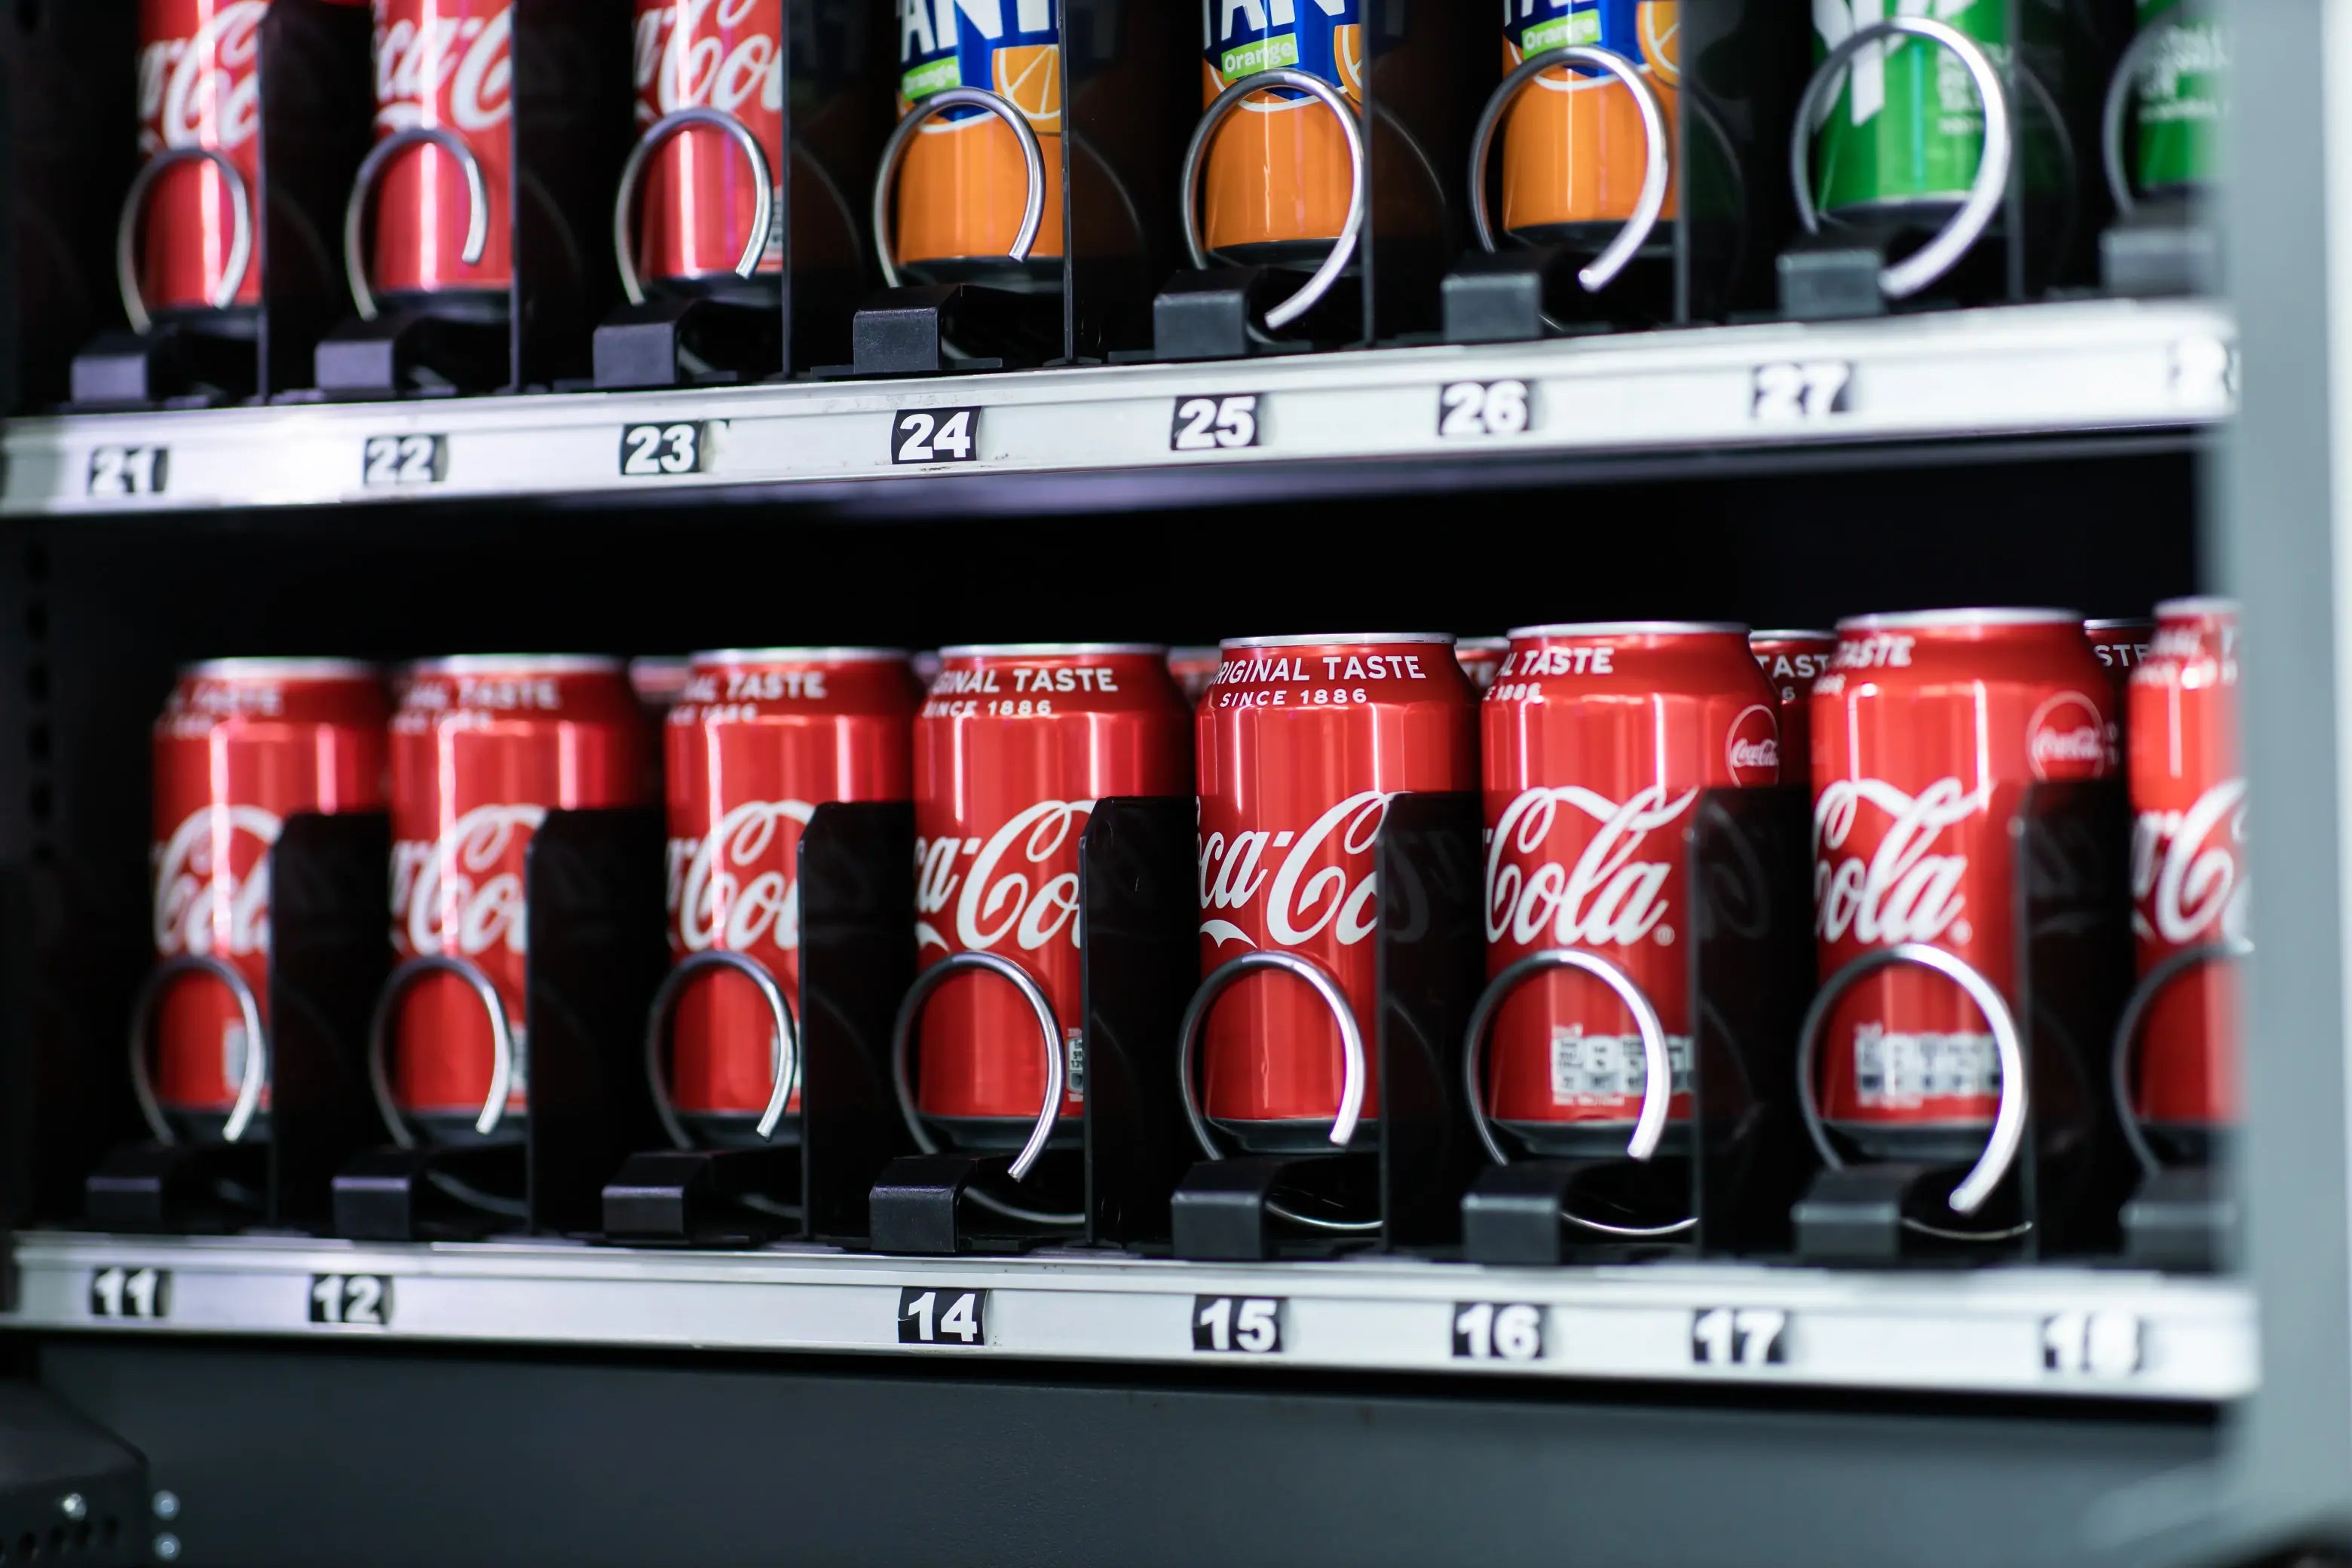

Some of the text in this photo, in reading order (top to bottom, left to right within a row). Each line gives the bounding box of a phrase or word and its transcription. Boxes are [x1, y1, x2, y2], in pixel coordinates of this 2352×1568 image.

[1224, 41, 1294, 73] Orange
[1525, 18, 1596, 51] Orange
[1441, 380, 1528, 433] 26
[1753, 362, 1849, 417] 27
[898, 412, 971, 461] 24
[1176, 396, 1257, 449] 25
[90, 445, 154, 495] 21
[365, 436, 435, 484] 22
[625, 424, 695, 474] 23
[726, 669, 827, 700] TASTE
[1013, 668, 1119, 693] TASTE
[1322, 655, 1427, 681] TASTE
[1521, 645, 1614, 676] TASTE
[988, 700, 1052, 717] 1886
[1220, 688, 1367, 709] SINCE 1886
[95, 1266, 156, 1319] 11
[313, 1275, 381, 1323] 12
[908, 1291, 977, 1343] 14
[1199, 1298, 1277, 1353] 15
[1456, 1303, 1540, 1358] 16
[1695, 1309, 1785, 1365] 17
